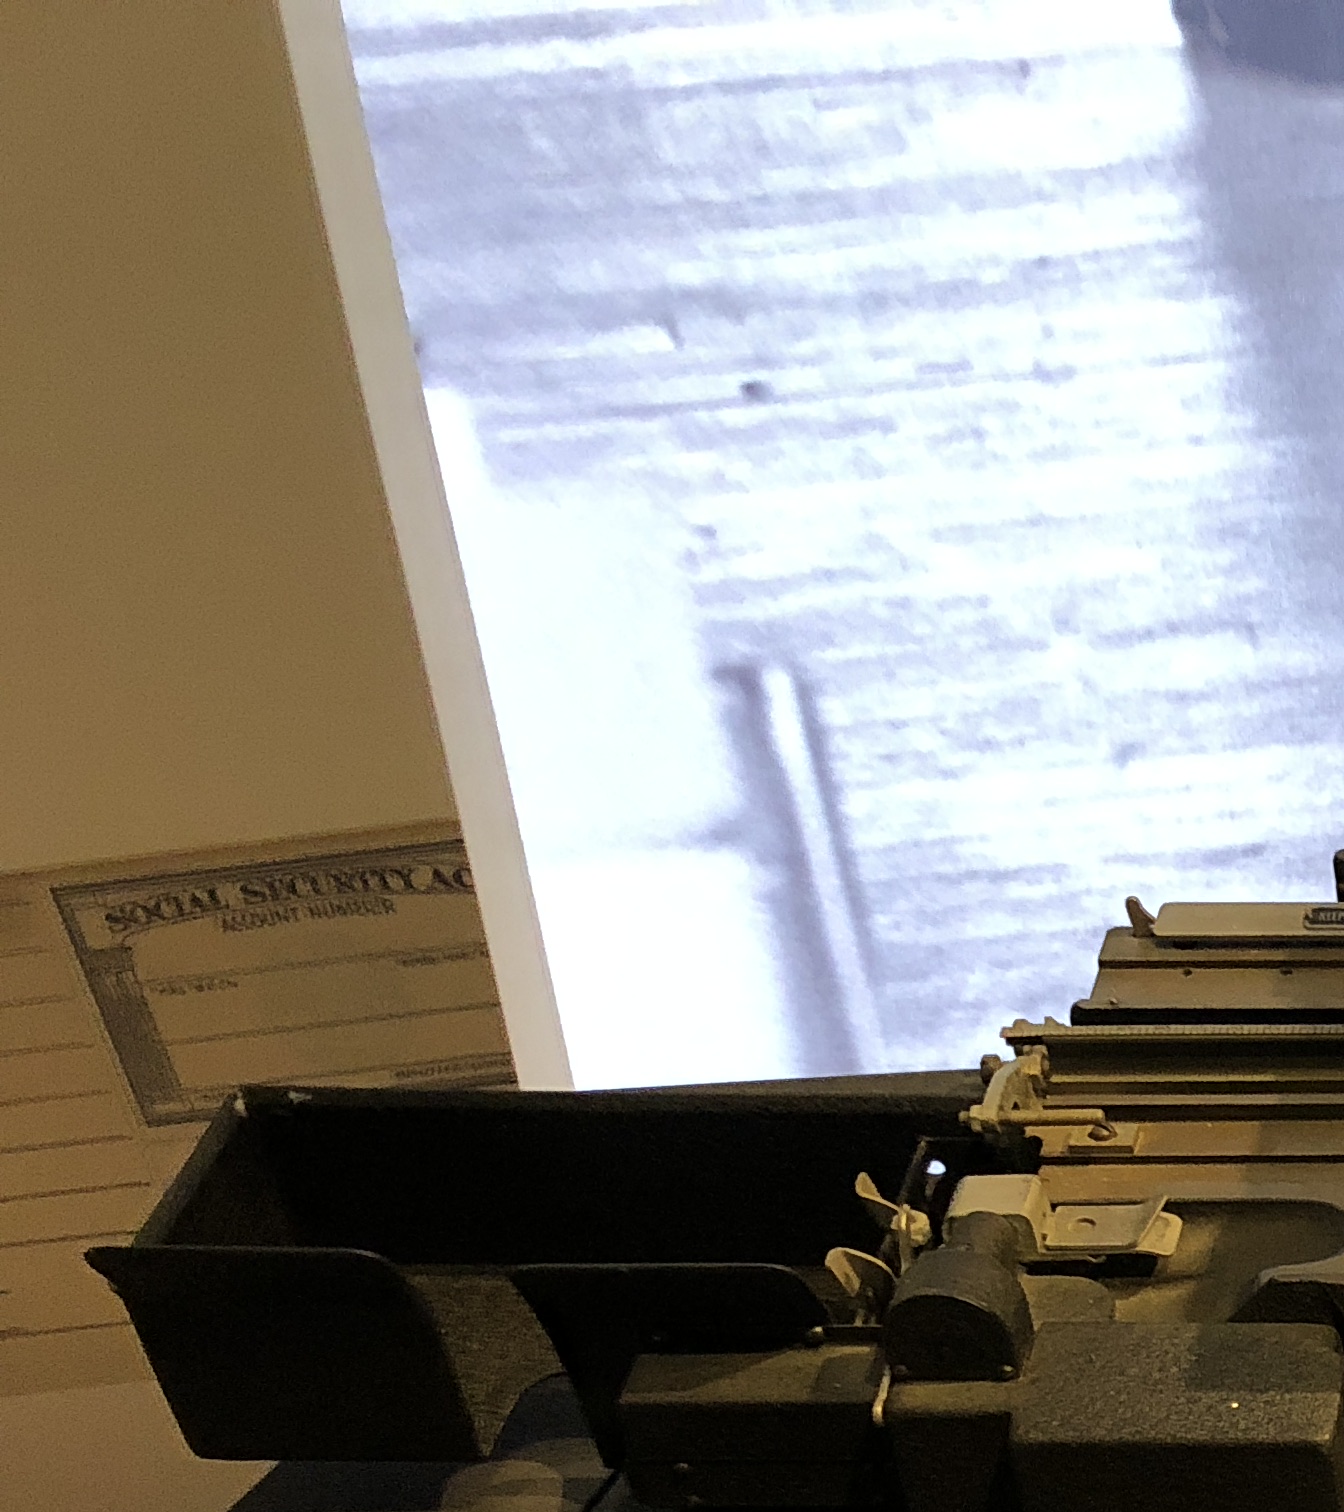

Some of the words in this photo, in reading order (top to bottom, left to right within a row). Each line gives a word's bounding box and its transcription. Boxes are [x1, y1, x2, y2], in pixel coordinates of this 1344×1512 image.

[105, 886, 230, 933] SOCIAL
[240, 866, 415, 906] SECURITY
[307, 898, 397, 919] NUMBER
[1318, 912, 1344, 922] KEEP
